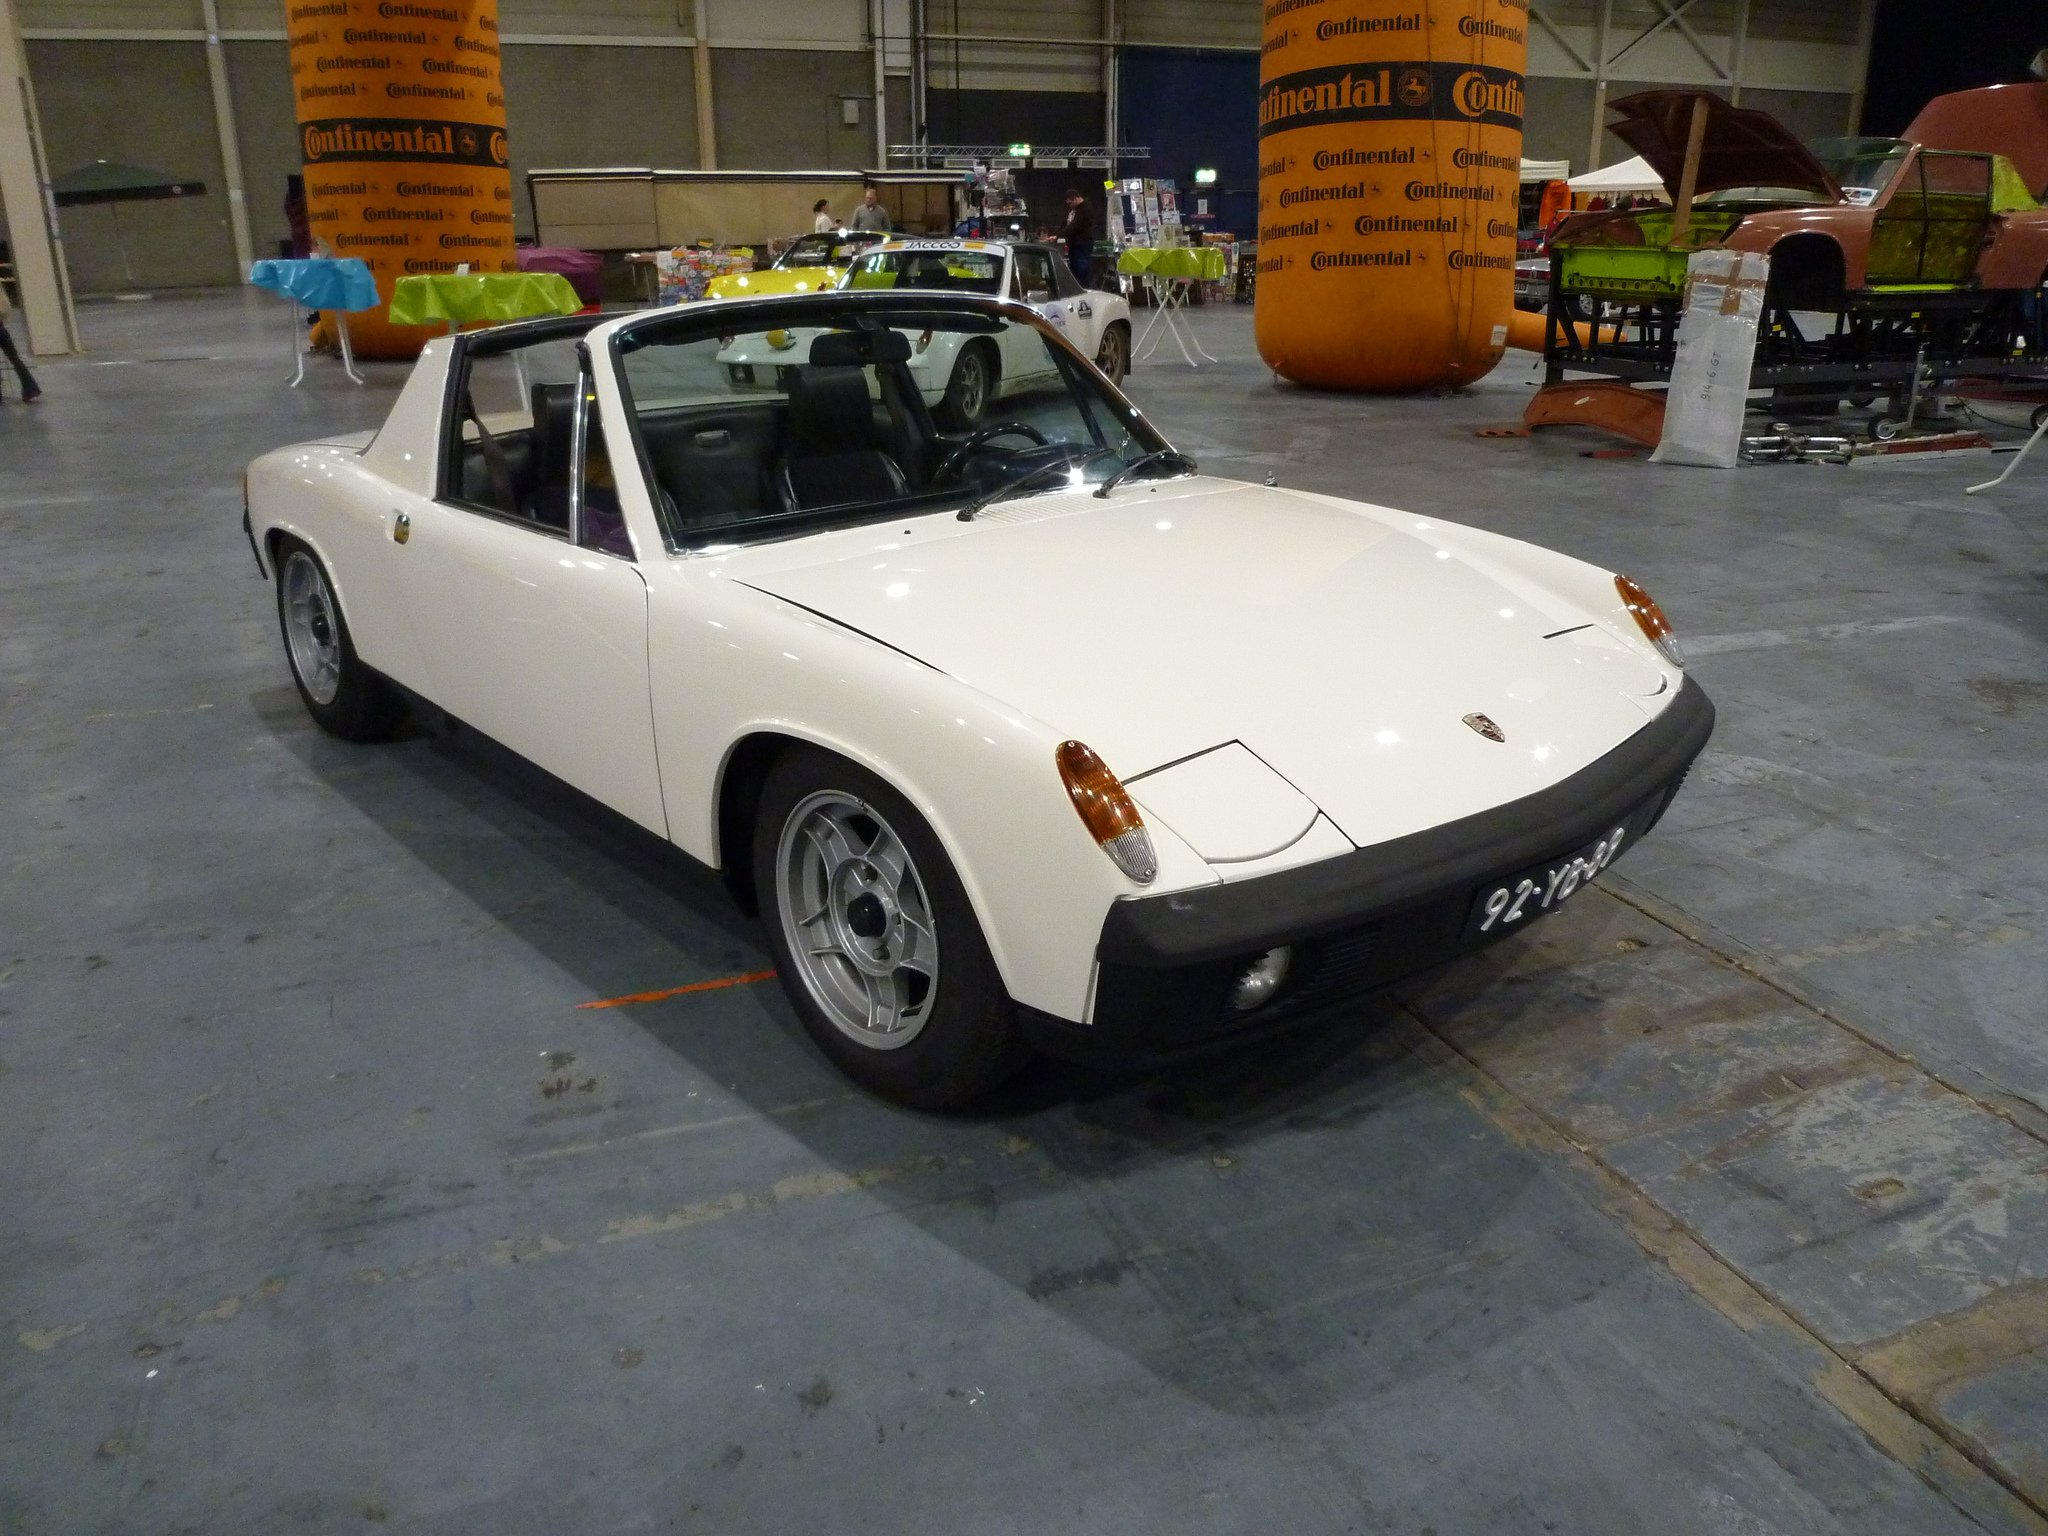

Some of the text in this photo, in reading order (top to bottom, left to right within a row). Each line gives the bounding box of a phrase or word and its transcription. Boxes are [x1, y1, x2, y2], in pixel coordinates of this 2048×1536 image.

[378, 2, 458, 22] Continental
[344, 28, 426, 45] Continental
[1316, 14, 1420, 41] Continental
[316, 56, 391, 73] Continental
[422, 58, 488, 79] Continental
[386, 82, 465, 100] Continental
[1452, 71, 1523, 119] Contin
[305, 123, 453, 160] Continental
[1313, 146, 1415, 171] Continental
[397, 181, 474, 197] Continental
[1280, 182, 1364, 209] Continental
[1405, 180, 1494, 202] Continental
[363, 206, 443, 223] Continental
[1355, 215, 1457, 236] Continental
[336, 233, 409, 249] Continental
[1311, 250, 1411, 272] Continental
